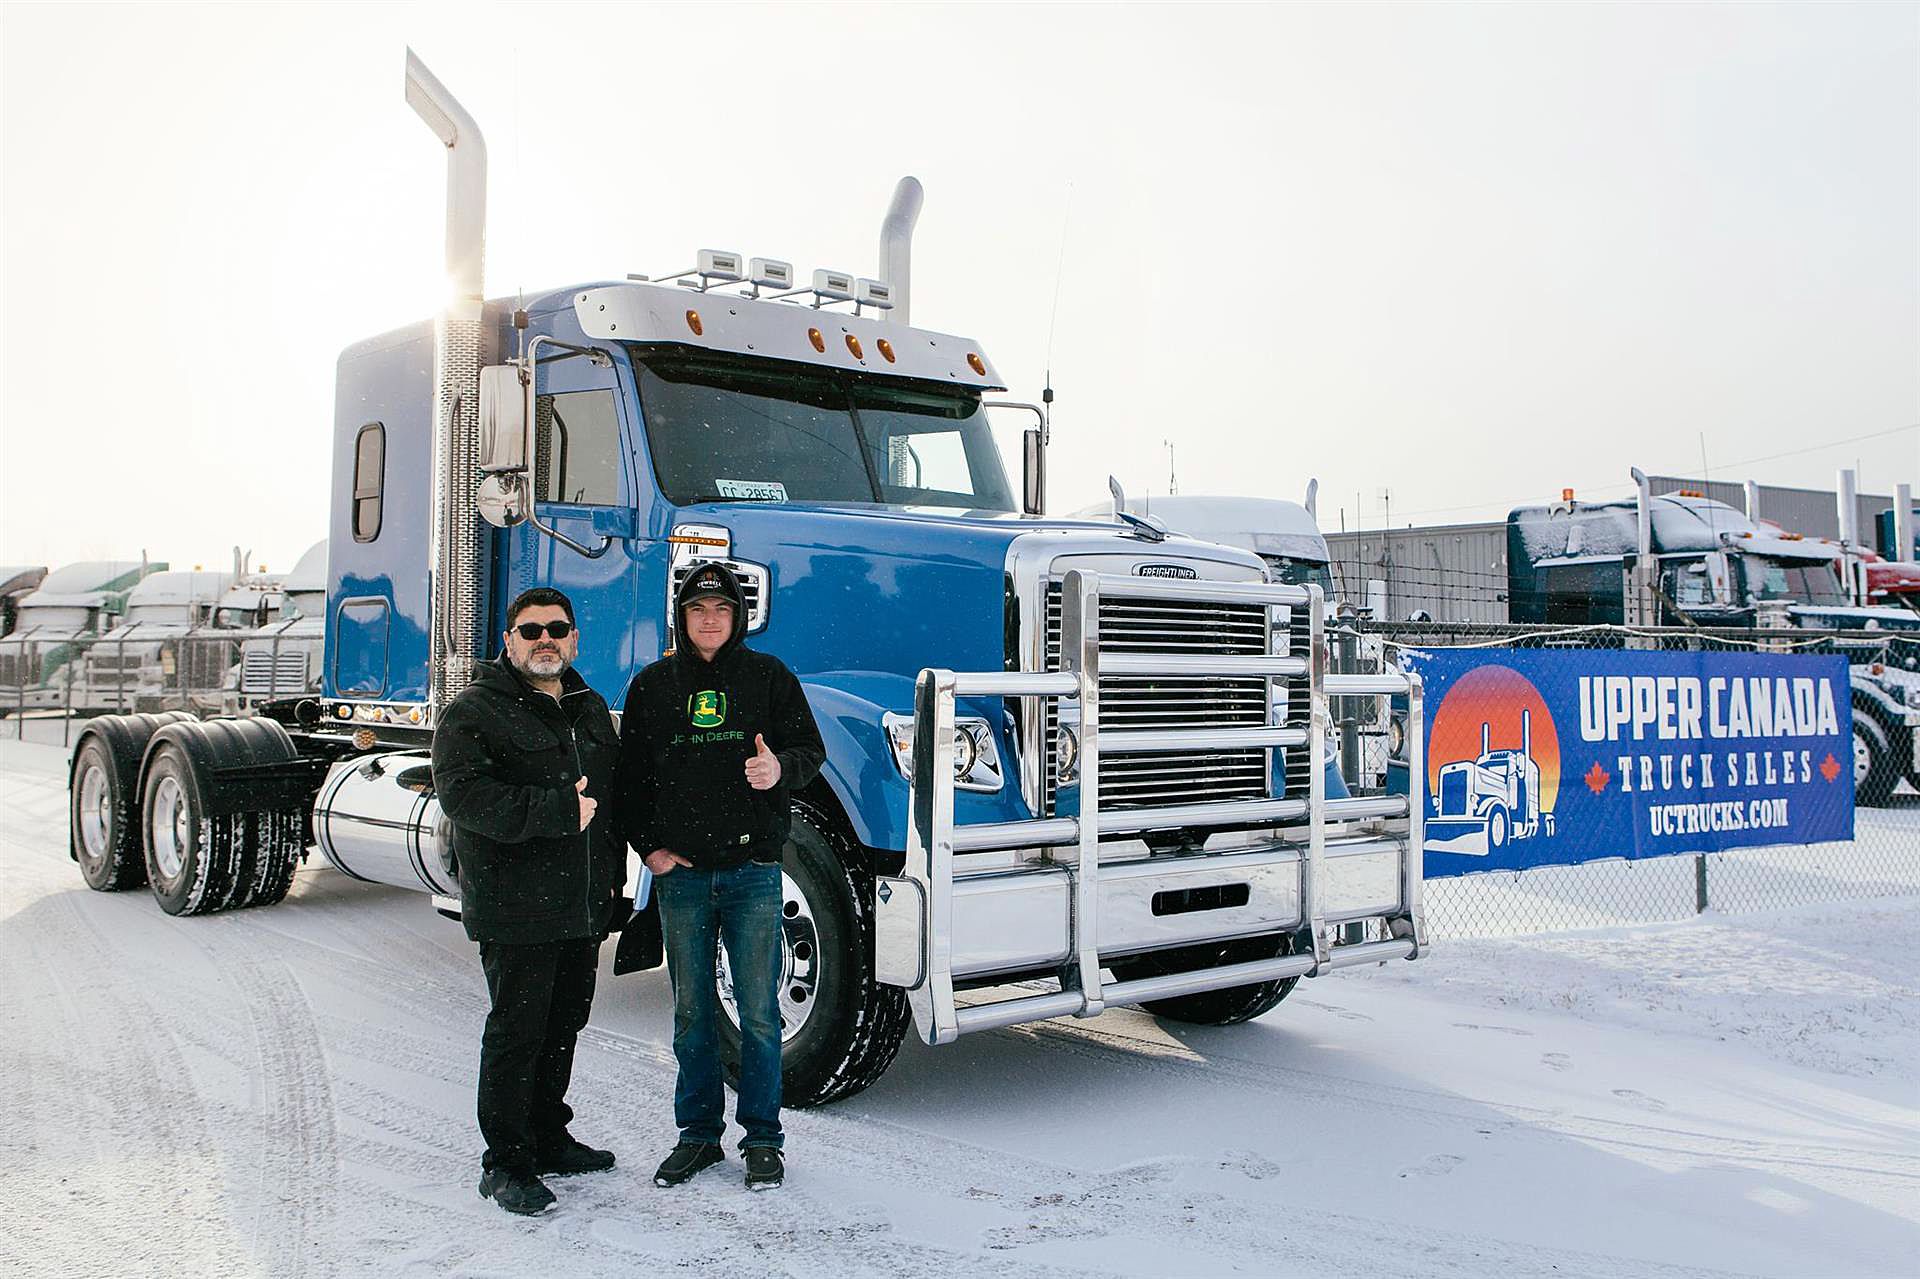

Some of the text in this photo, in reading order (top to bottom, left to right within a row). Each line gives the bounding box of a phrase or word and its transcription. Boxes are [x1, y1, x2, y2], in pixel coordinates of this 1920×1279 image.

[1142, 567, 1195, 579] FREIGHTLINER
[1578, 676, 1839, 742] UPPER CANADA
[706, 730, 745, 742] DEERE
[1618, 750, 1812, 792] TRUCK SALES
[1649, 798, 1789, 837] UCTRUCKS.COM
